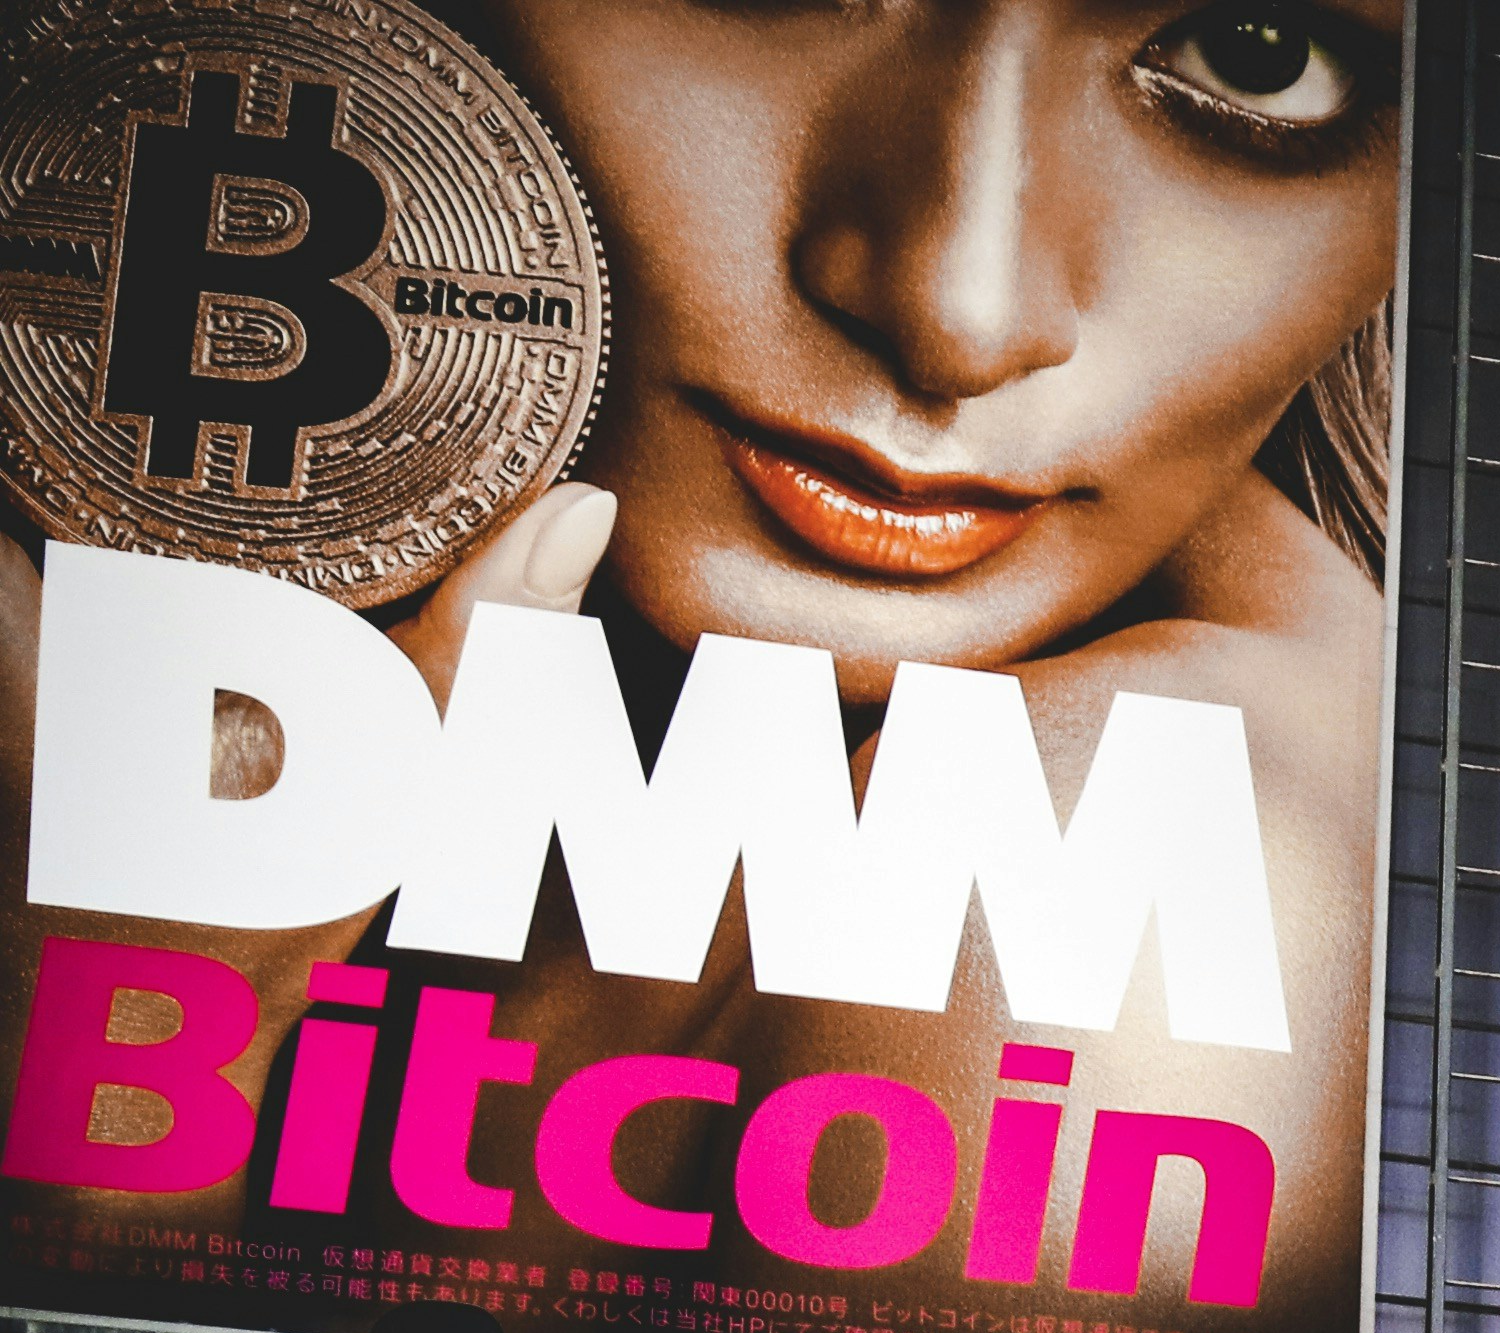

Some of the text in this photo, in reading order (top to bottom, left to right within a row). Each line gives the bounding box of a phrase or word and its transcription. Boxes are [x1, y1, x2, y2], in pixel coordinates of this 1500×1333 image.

[394, 276, 573, 329] Bitcoin
[27, 539, 1292, 1053] DMM
[3, 935, 1276, 1309] Bitcoin
[208, 1233, 301, 1262] Bitcoin
